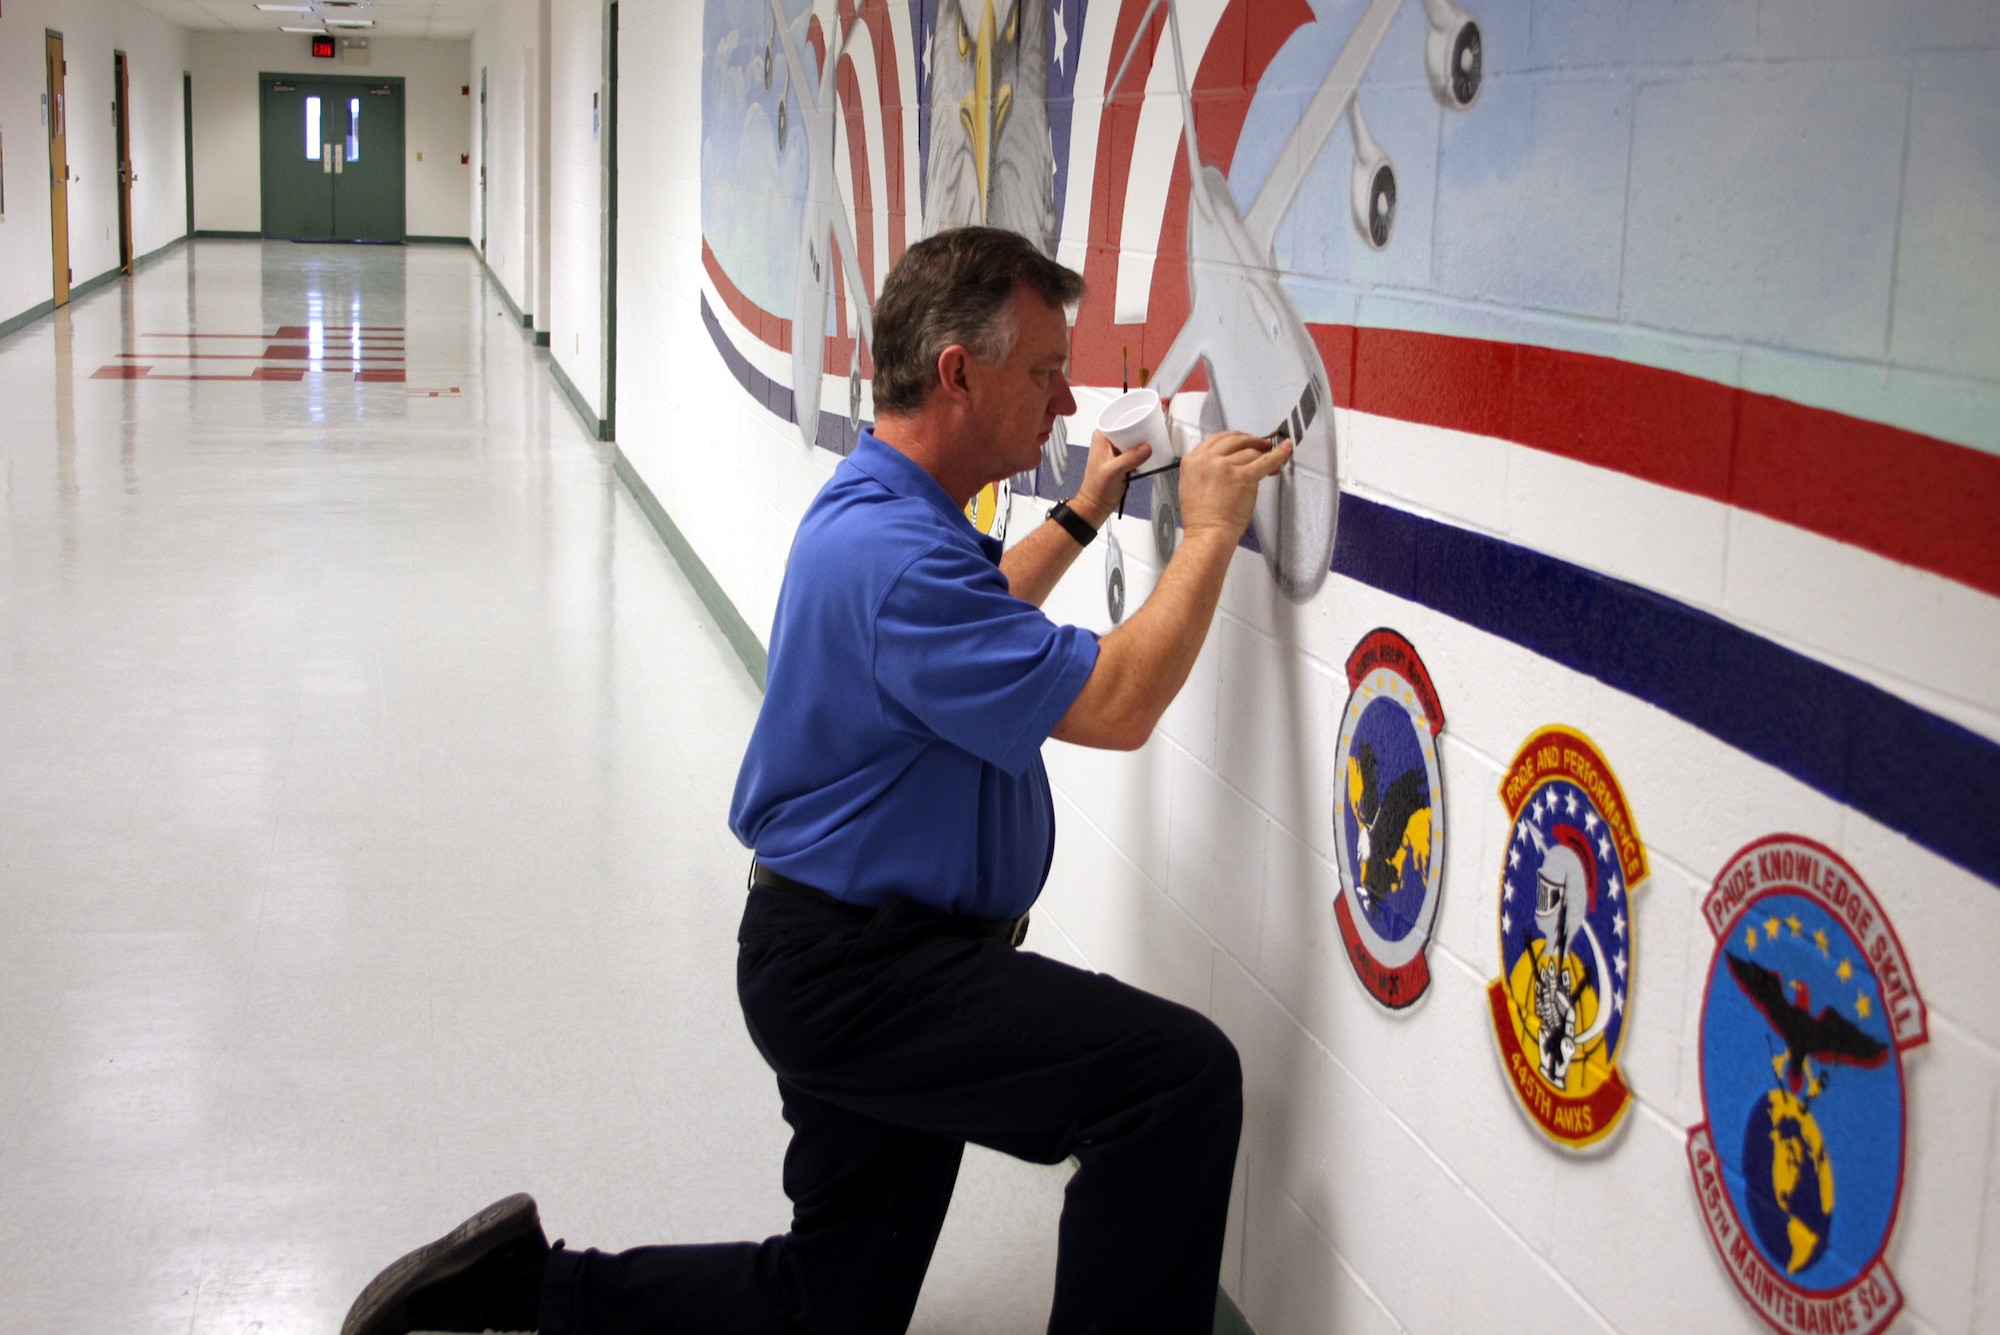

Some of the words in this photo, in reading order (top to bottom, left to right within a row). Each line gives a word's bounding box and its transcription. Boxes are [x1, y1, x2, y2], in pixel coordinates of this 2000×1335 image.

[314, 42, 332, 56] EXIT
[1506, 757, 1534, 806] PRIDE
[1537, 746, 1559, 772] AND
[1563, 749, 1639, 876] PERFORMANCE
[1757, 850, 1873, 940] KNOWLEDGE
[1870, 935, 1911, 1035] SKILL
[1512, 1053, 1551, 1118] 445TH
[1554, 1105, 1593, 1132] AMXS
[1697, 1149, 1731, 1237] 445TH
[1730, 1237, 1858, 1335] MAINTENANCE
[1857, 1273, 1887, 1320] SQ
